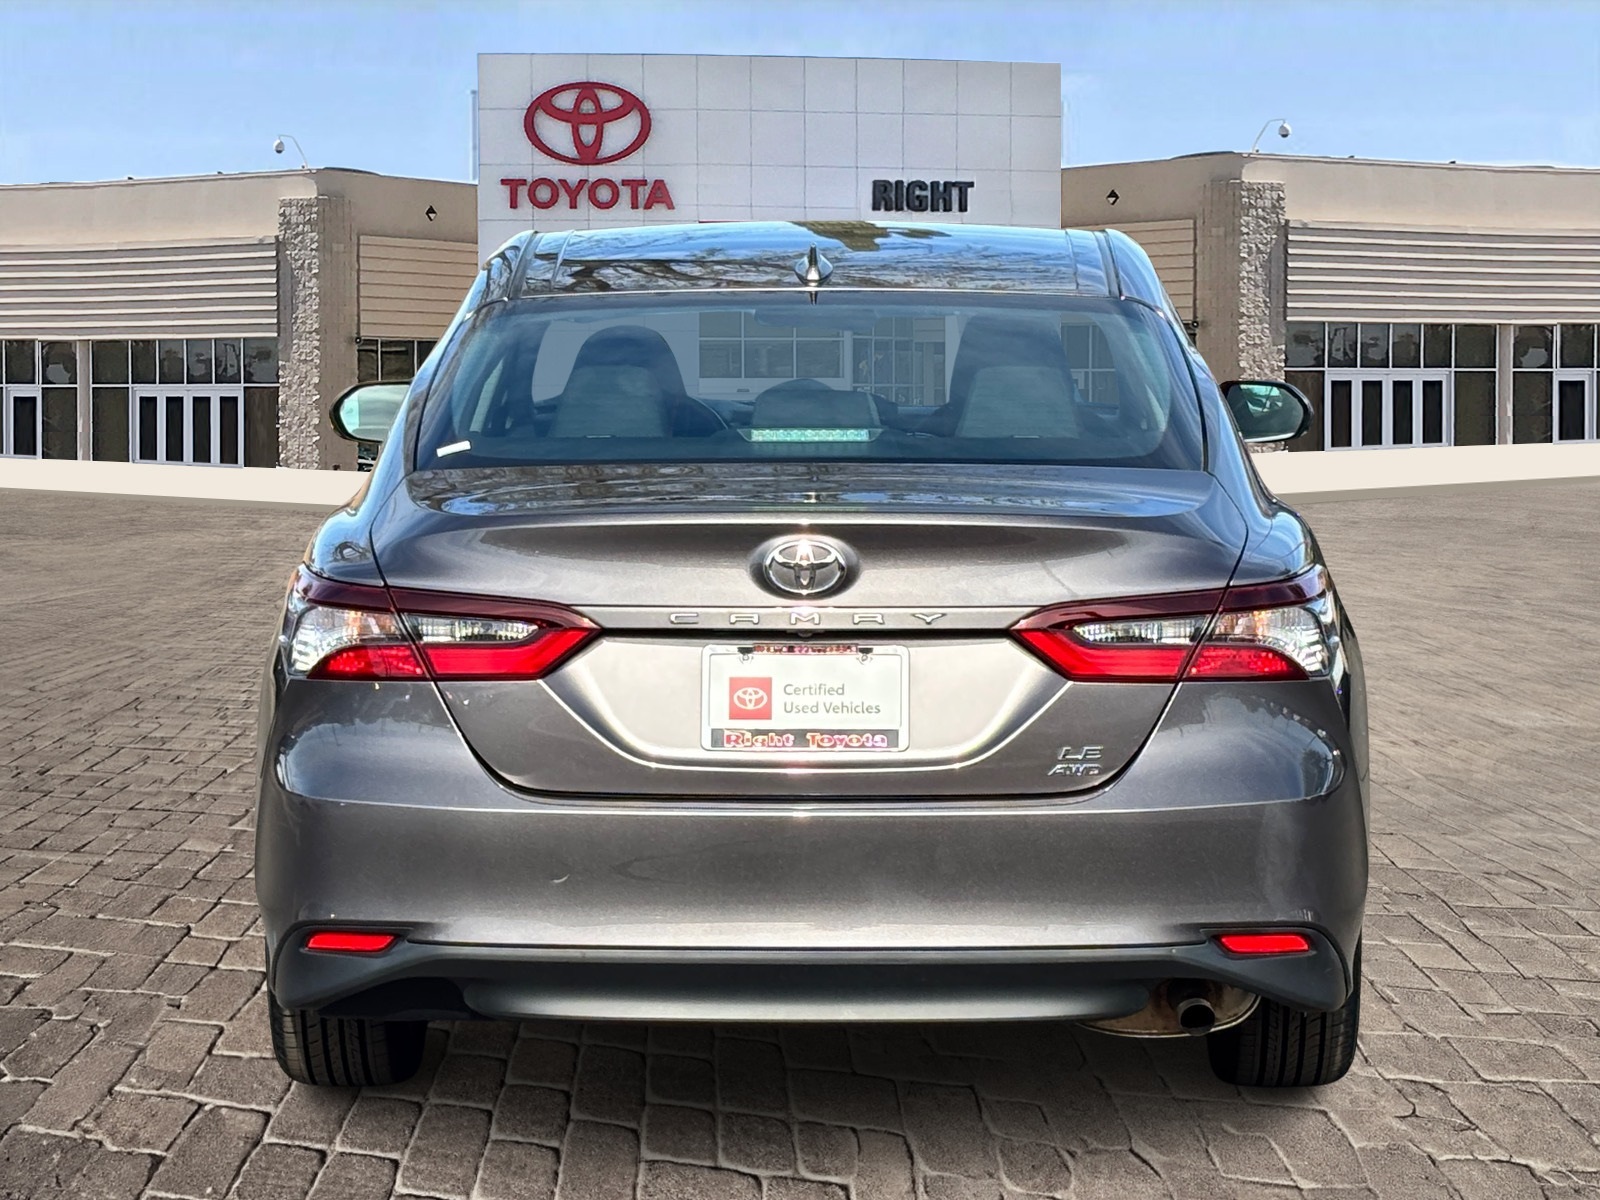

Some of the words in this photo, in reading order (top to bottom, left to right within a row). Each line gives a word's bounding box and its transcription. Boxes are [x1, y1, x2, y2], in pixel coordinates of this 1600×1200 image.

[500, 178, 675, 210] TOYOTA
[871, 179, 975, 213] RIGHT
[668, 611, 947, 626] CAMRY
[783, 683, 845, 697] Certified
[783, 701, 819, 714] Used
[825, 701, 881, 714] Vehicles
[724, 729, 795, 748] Right
[806, 732, 888, 748] Toyota
[1058, 745, 1103, 760] LE
[1047, 763, 1103, 776] AWD
